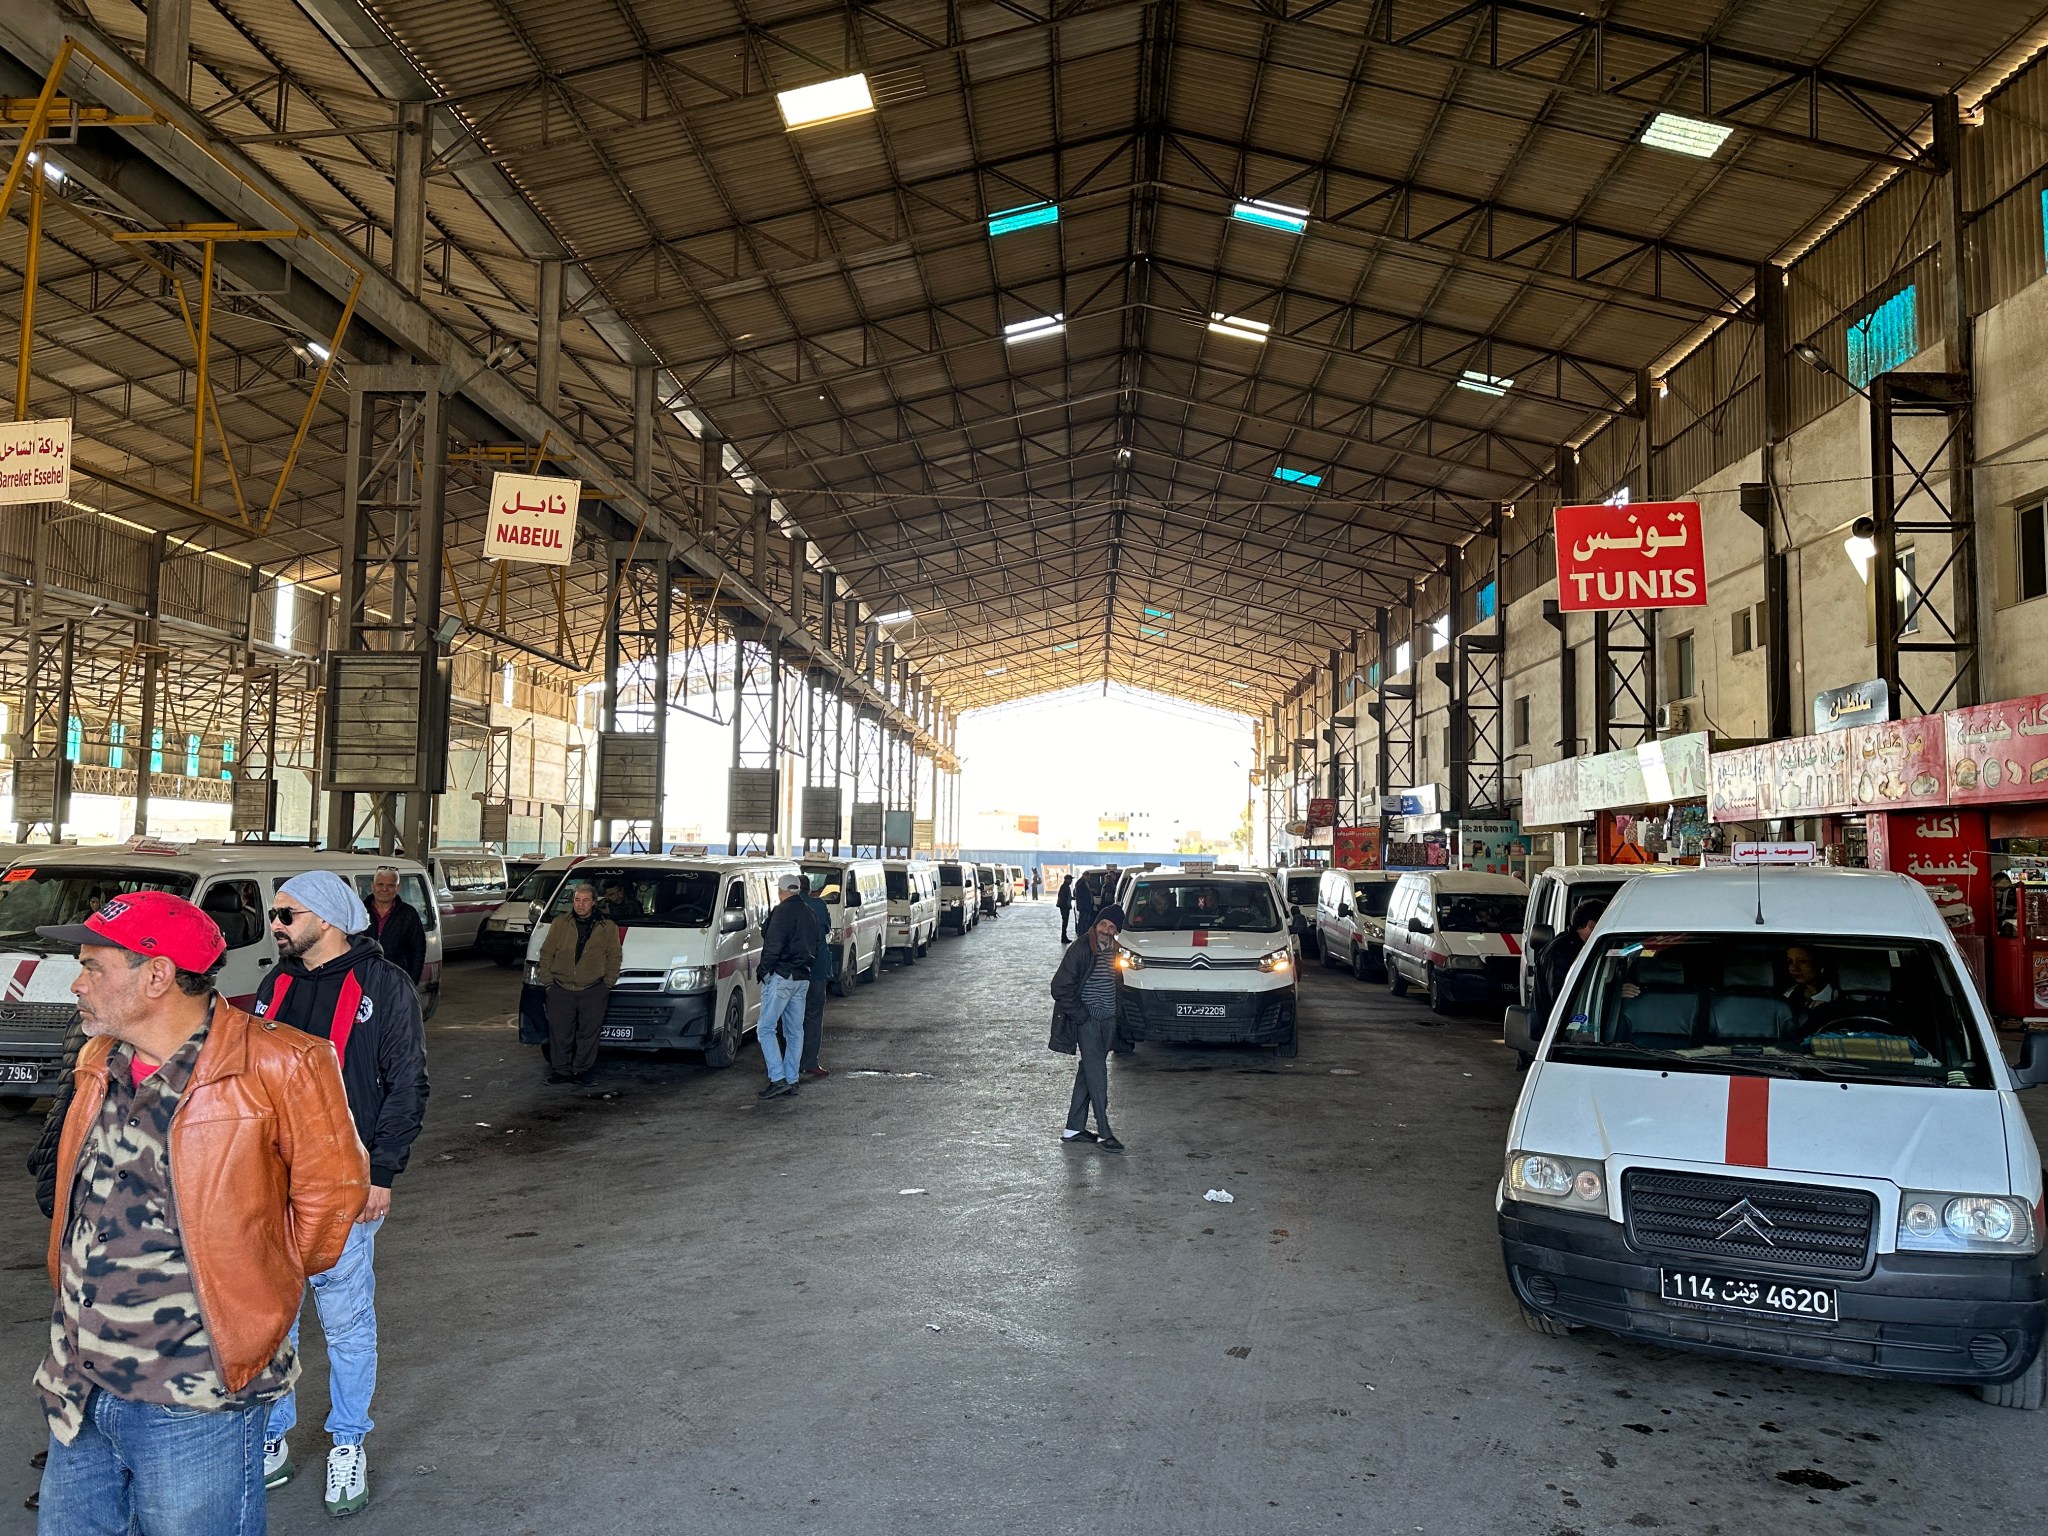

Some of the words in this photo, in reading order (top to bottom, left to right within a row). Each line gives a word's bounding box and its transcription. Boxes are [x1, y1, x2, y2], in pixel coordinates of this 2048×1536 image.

[33, 465, 64, 486] Essehel
[501, 490, 567, 518] نابل
[496, 523, 563, 549] NABEUL
[1572, 511, 1688, 562] تونس
[1569, 567, 1697, 602] TUNIS
[1828, 692, 1874, 723] سلطان
[1916, 813, 1960, 838] أكلة
[1739, 847, 1767, 857] تونس
[1774, 846, 1809, 856] سوسة
[1907, 853, 1979, 882] خفيفة
[1204, 1006, 1224, 1016] 2209
[611, 1028, 631, 1038] 4969
[7, 1066, 33, 1080] 7964
[1673, 1273, 1716, 1300] 114
[1721, 1280, 1760, 1305] تونس
[1765, 1285, 1830, 1314] 4620
